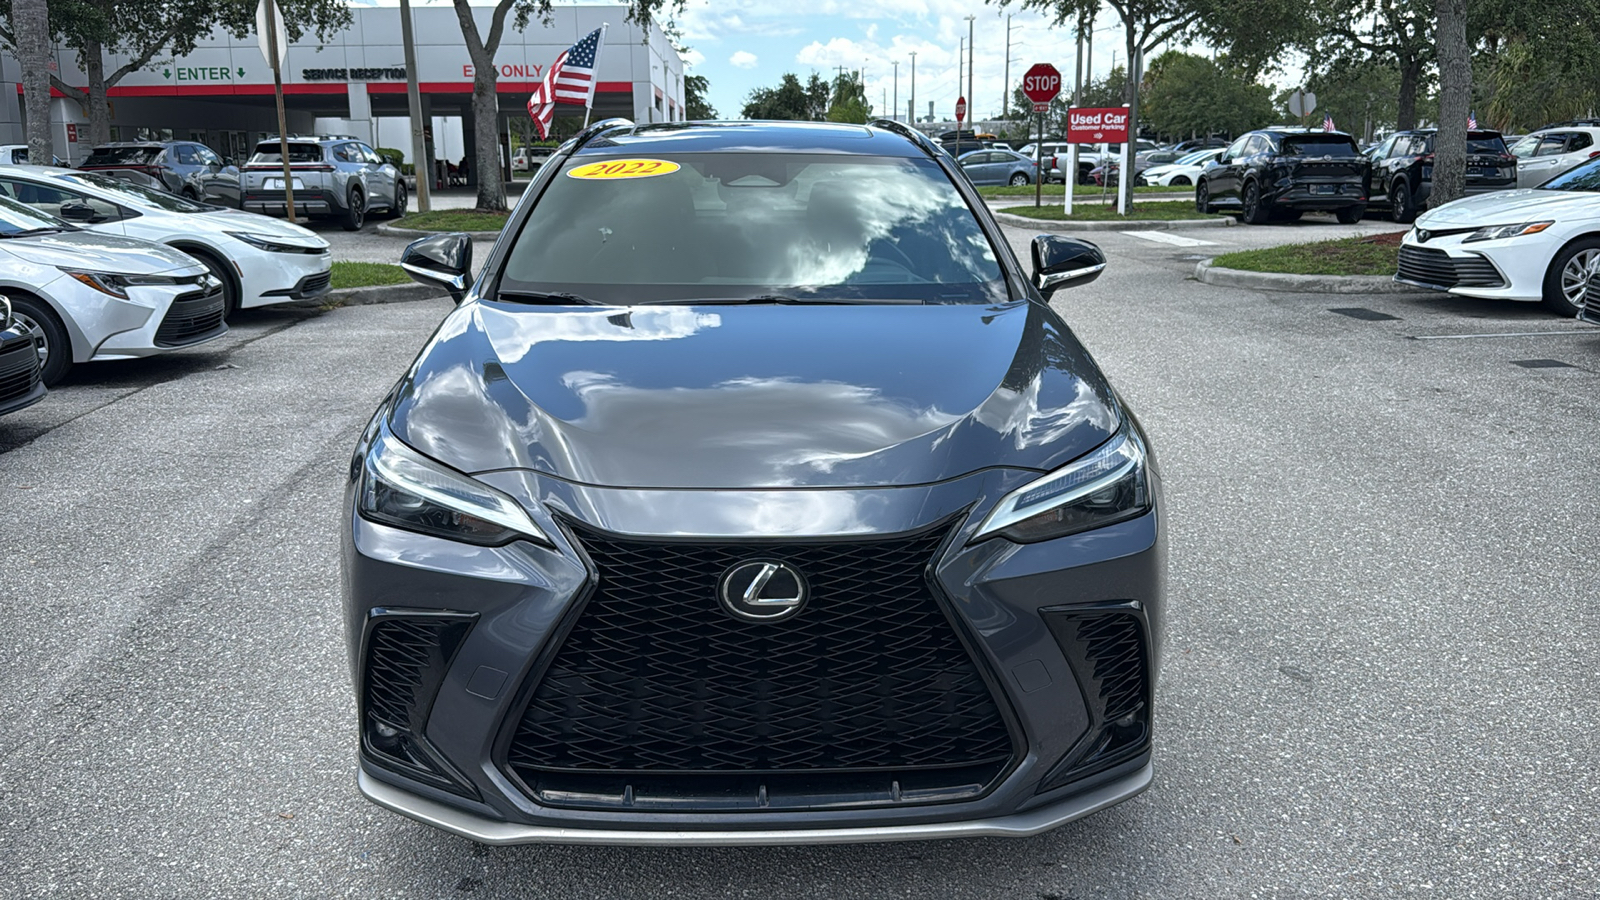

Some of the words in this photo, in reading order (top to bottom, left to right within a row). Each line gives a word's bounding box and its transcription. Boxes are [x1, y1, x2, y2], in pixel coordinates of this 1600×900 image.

[177, 67, 231, 80] ENTER
[302, 68, 348, 80] SERVICE
[350, 68, 408, 79] RECEPTION
[501, 65, 543, 77] ONLY
[1026, 76, 1059, 91] STOP
[1071, 113, 1102, 125] Used
[1104, 113, 1126, 124] Car
[584, 162, 662, 176] 2022
